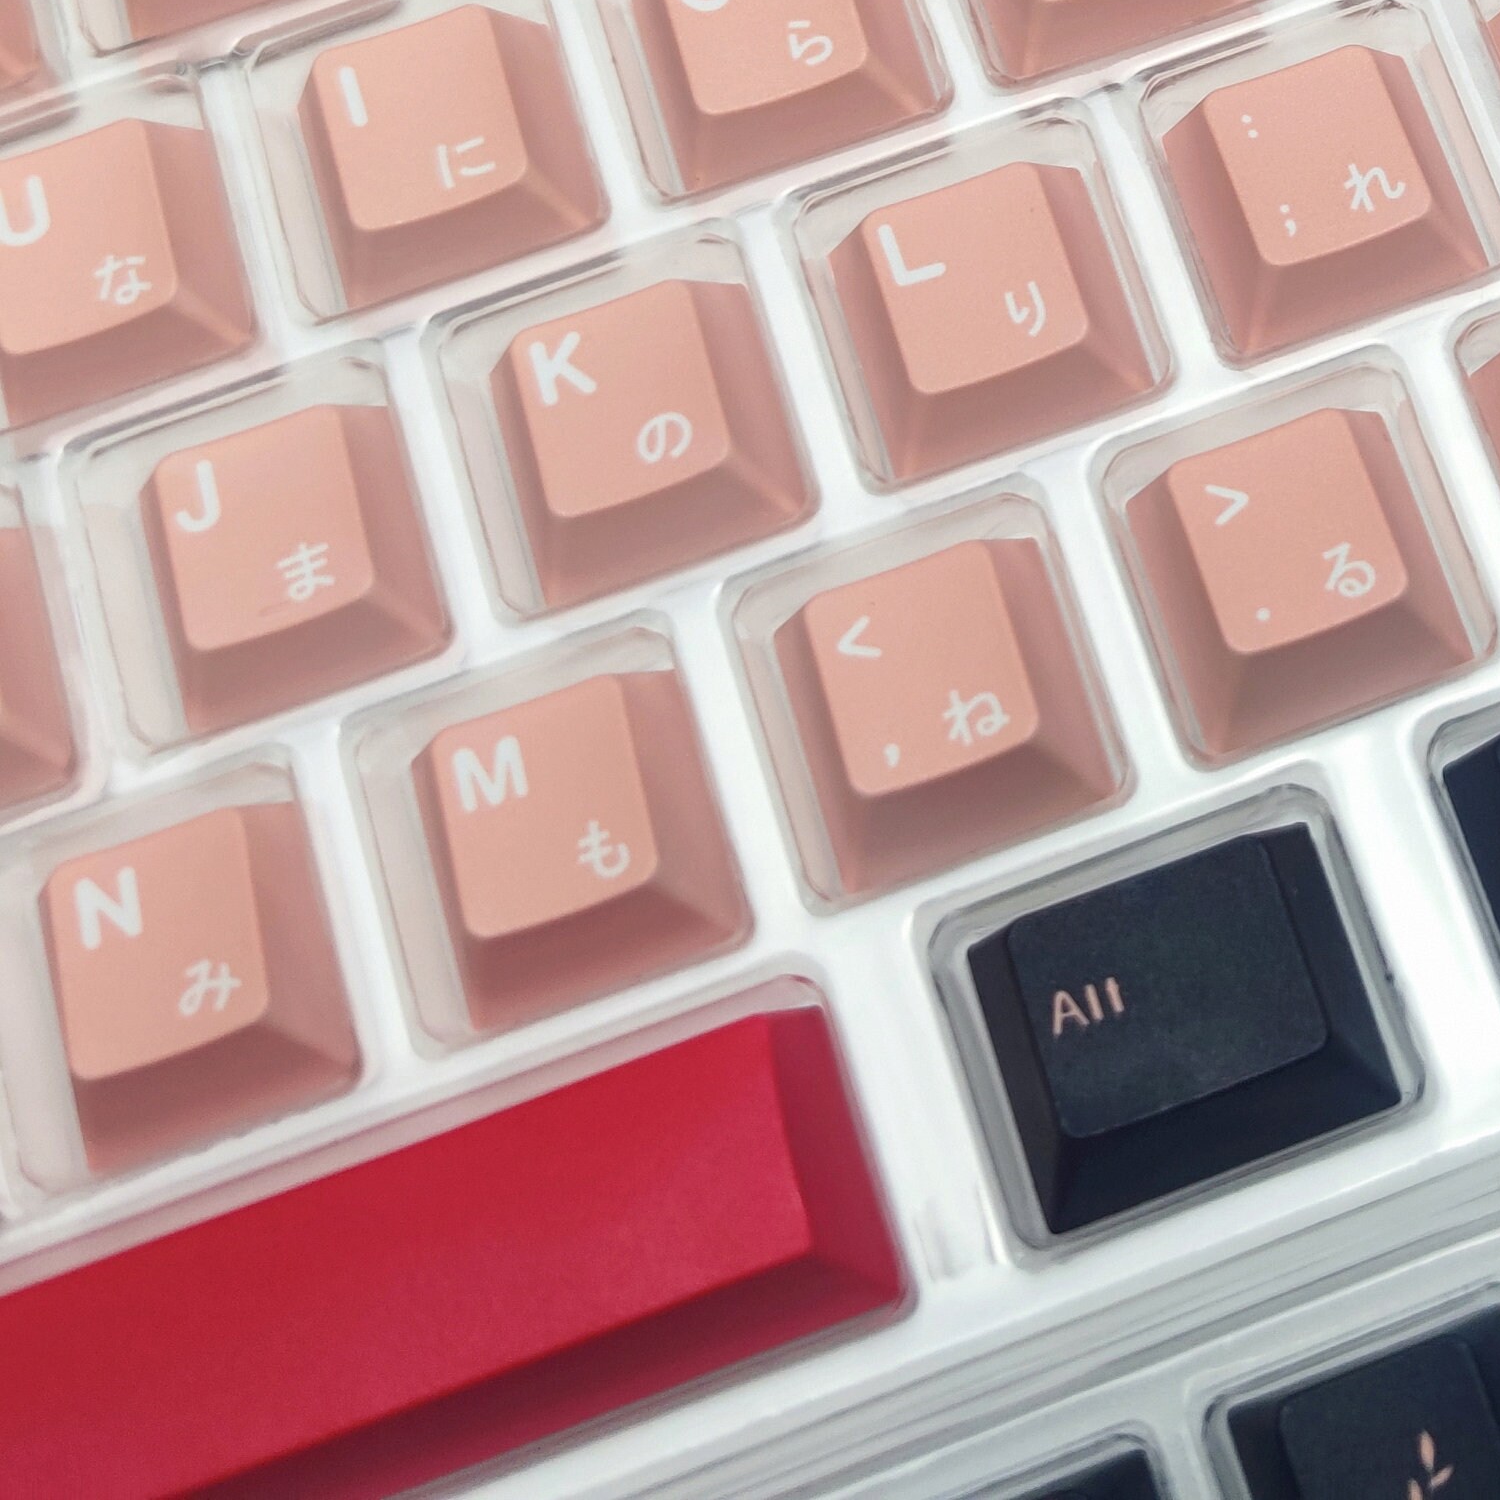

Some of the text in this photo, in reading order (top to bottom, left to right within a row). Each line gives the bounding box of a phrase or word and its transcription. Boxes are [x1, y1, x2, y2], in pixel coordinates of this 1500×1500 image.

[788, 19, 833, 66] ら
[436, 136, 496, 190] に
[1344, 162, 1407, 213] れ
[0, 176, 51, 247] U
[93, 255, 153, 305] な
[877, 224, 947, 288] L
[1004, 282, 1048, 337] り
[527, 331, 596, 407] K
[635, 411, 692, 464] の
[176, 461, 223, 533] J
[277, 541, 335, 601] ま
[1322, 541, 1377, 597] る
[942, 689, 1009, 746] ね
[451, 735, 529, 813] M
[577, 819, 630, 879] も
[73, 866, 143, 951] N
[177, 959, 241, 1018] み
